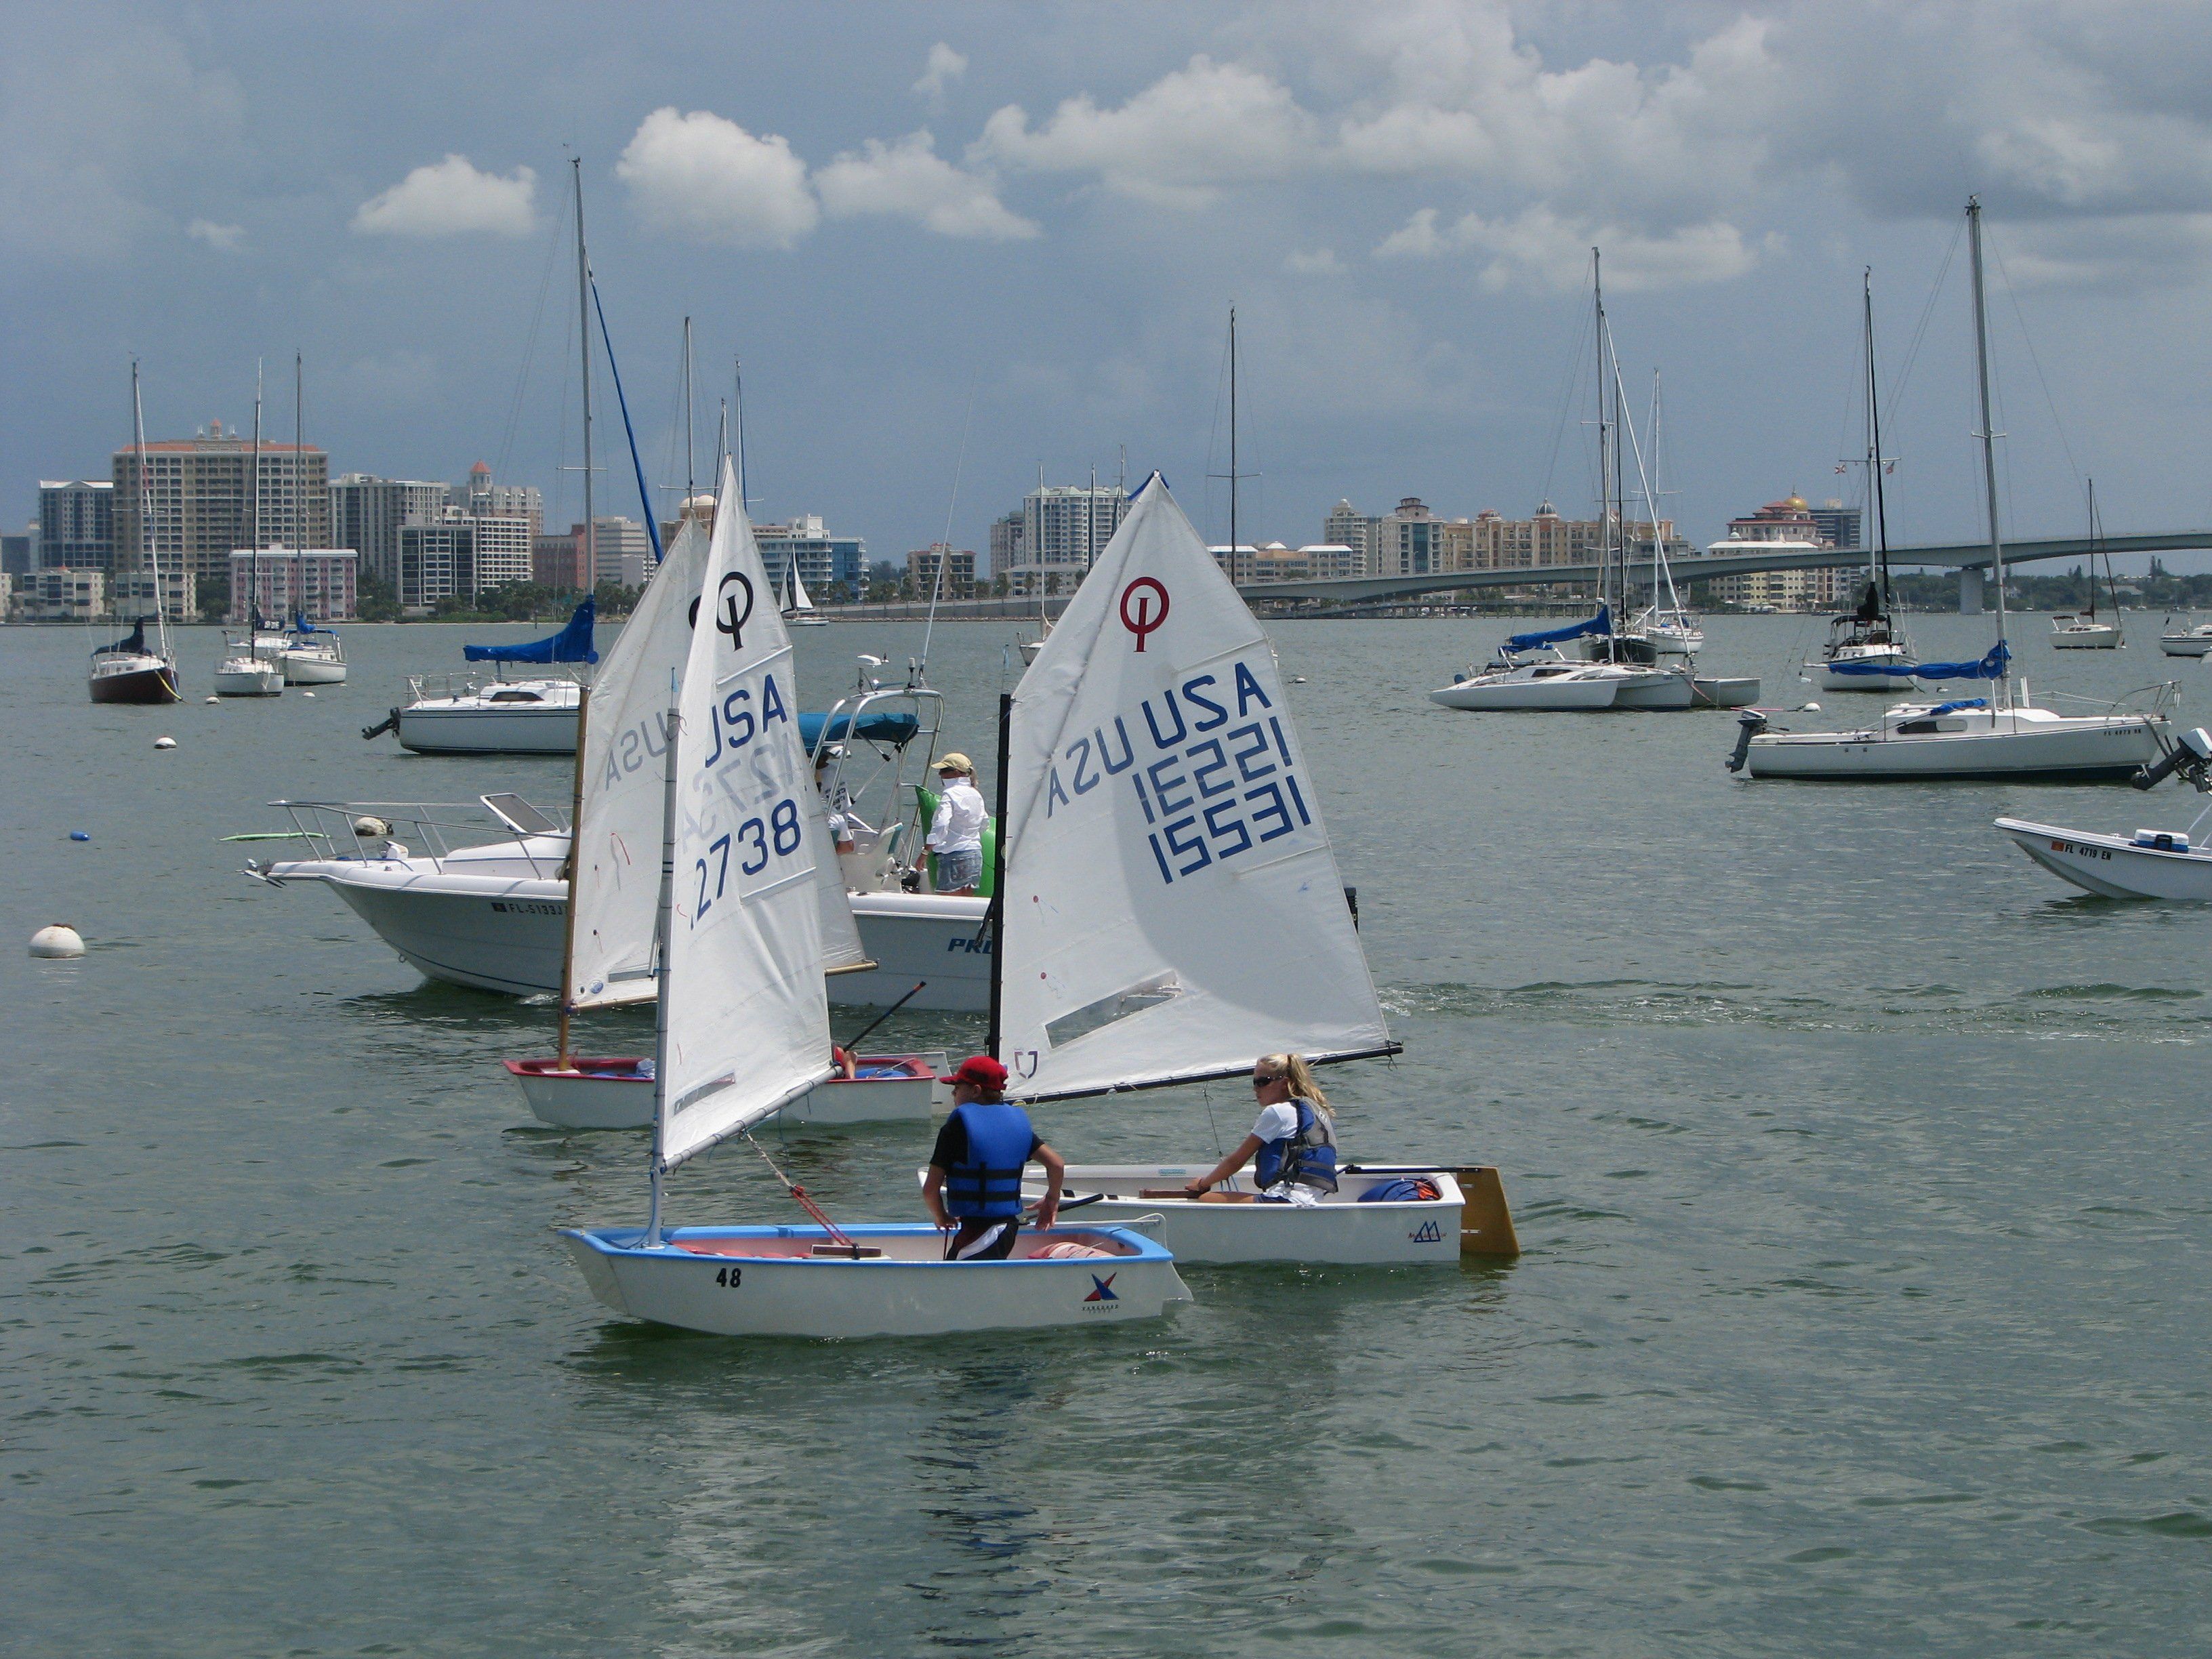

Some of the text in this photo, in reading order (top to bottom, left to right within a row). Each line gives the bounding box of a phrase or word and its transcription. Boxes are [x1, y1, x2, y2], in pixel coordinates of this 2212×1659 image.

[1141, 661, 1272, 750] USA
[690, 798, 802, 931] 2738
[1148, 775, 1311, 884] 15531
[2064, 844, 2074, 854] FL
[716, 1267, 741, 1288] 48
